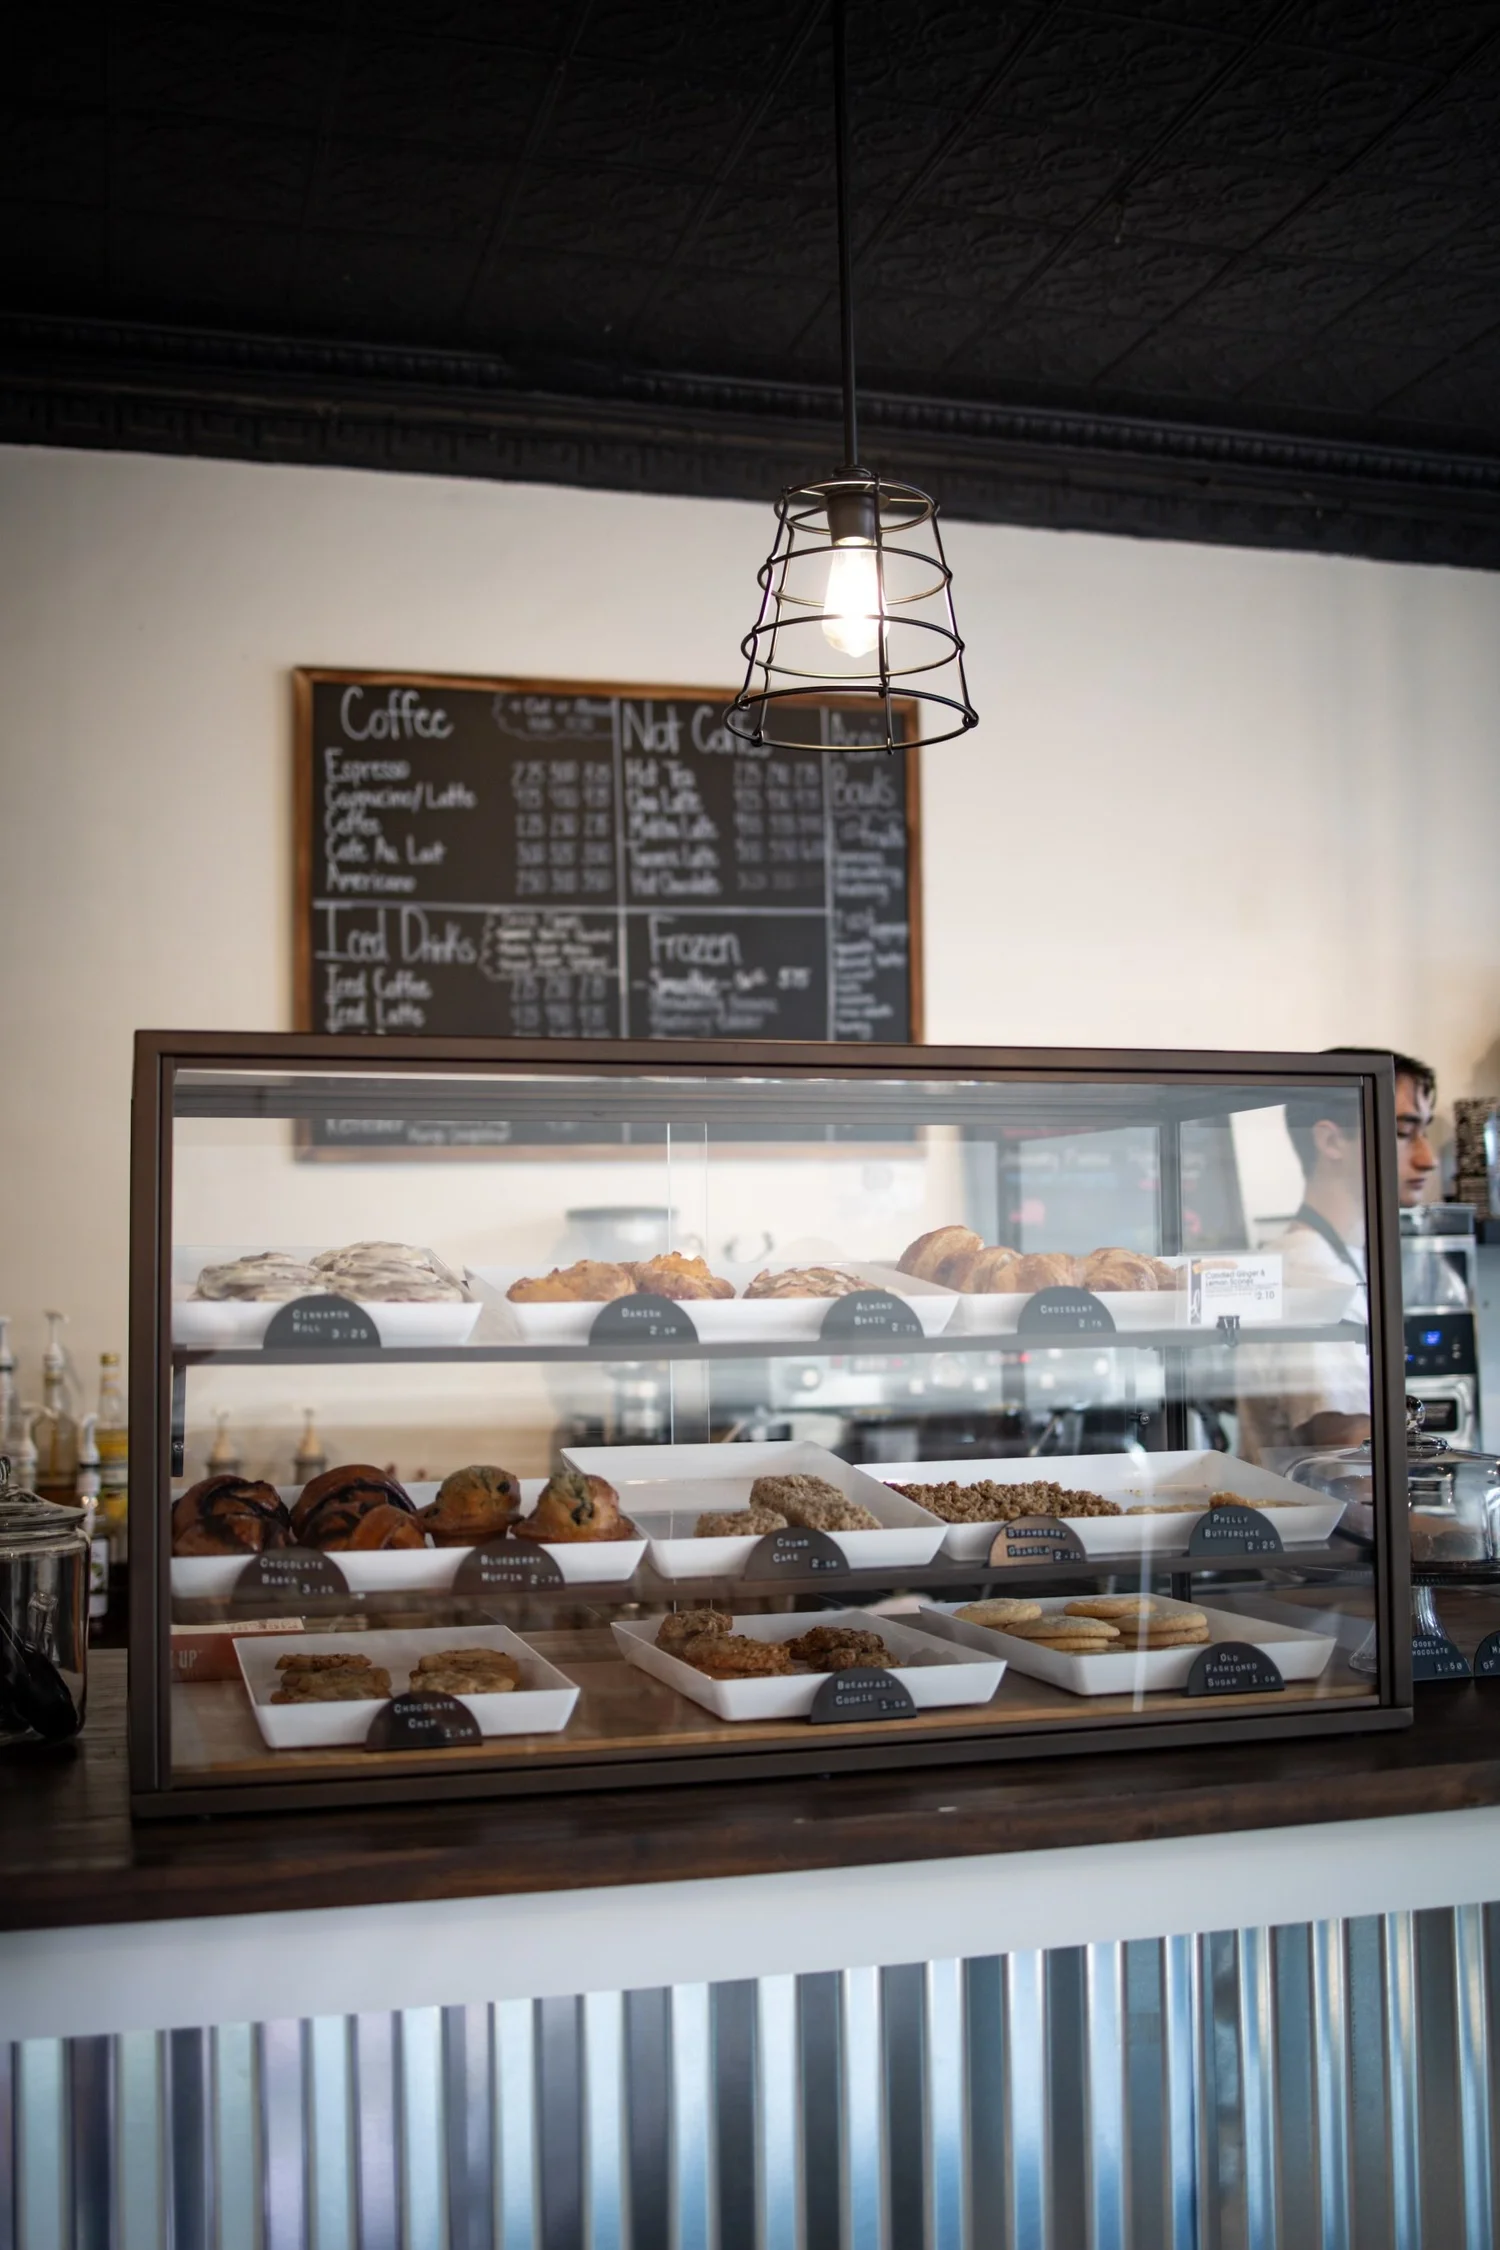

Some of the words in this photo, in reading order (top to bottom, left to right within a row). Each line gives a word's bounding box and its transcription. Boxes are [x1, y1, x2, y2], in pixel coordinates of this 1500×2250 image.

[340, 685, 454, 741] Coffee
[622, 697, 683, 754] Not
[325, 747, 411, 785] Espresso
[314, 902, 389, 963] Iced
[401, 905, 476, 964] Drinks
[650, 912, 742, 966] Frozen
[1247, 1540, 1275, 1550] 2.25
[1412, 1640, 1437, 1648] GOOEY
[1412, 1648, 1448, 1656] HOCOLATE
[179, 1651, 197, 1669] UP
[1483, 1660, 1495, 1670] GF
